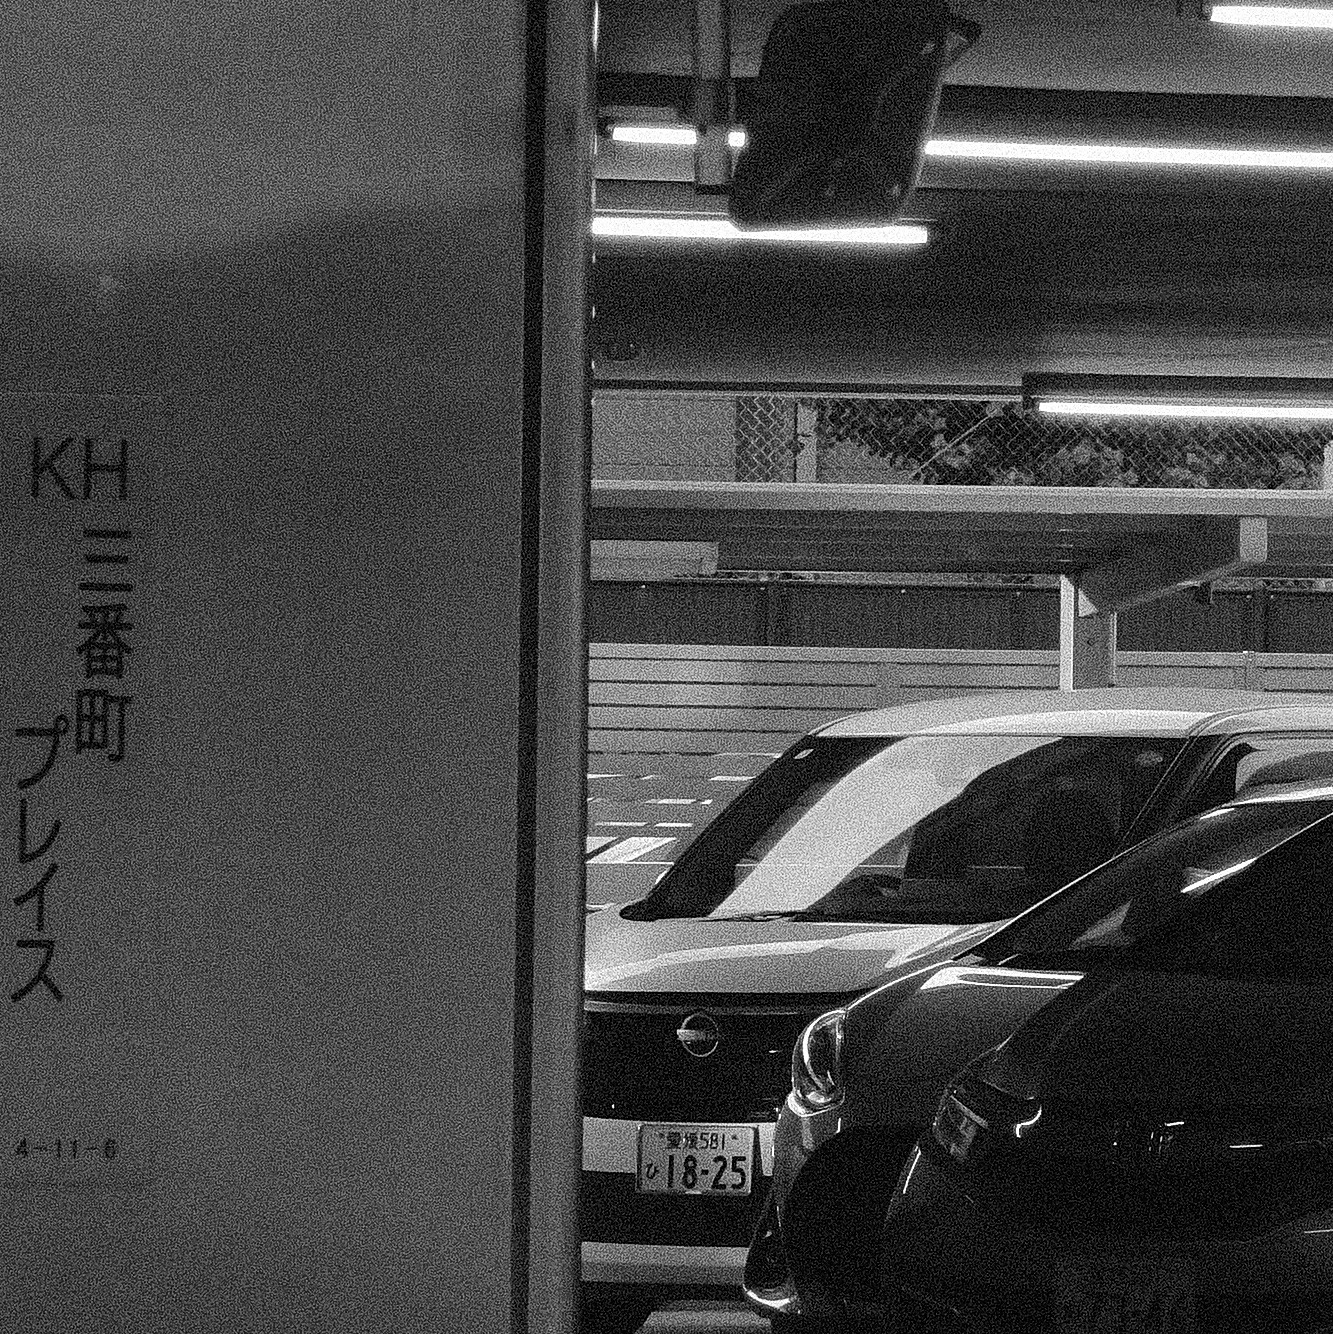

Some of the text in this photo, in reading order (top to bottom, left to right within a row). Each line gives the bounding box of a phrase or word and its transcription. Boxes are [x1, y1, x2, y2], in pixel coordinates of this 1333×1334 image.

[30, 436, 129, 501] KH
[76, 528, 134, 763] 三番町
[10, 714, 71, 1004] プレイス
[14, 1138, 118, 1160] 4-11-6
[667, 1154, 747, 1190] 18-25
